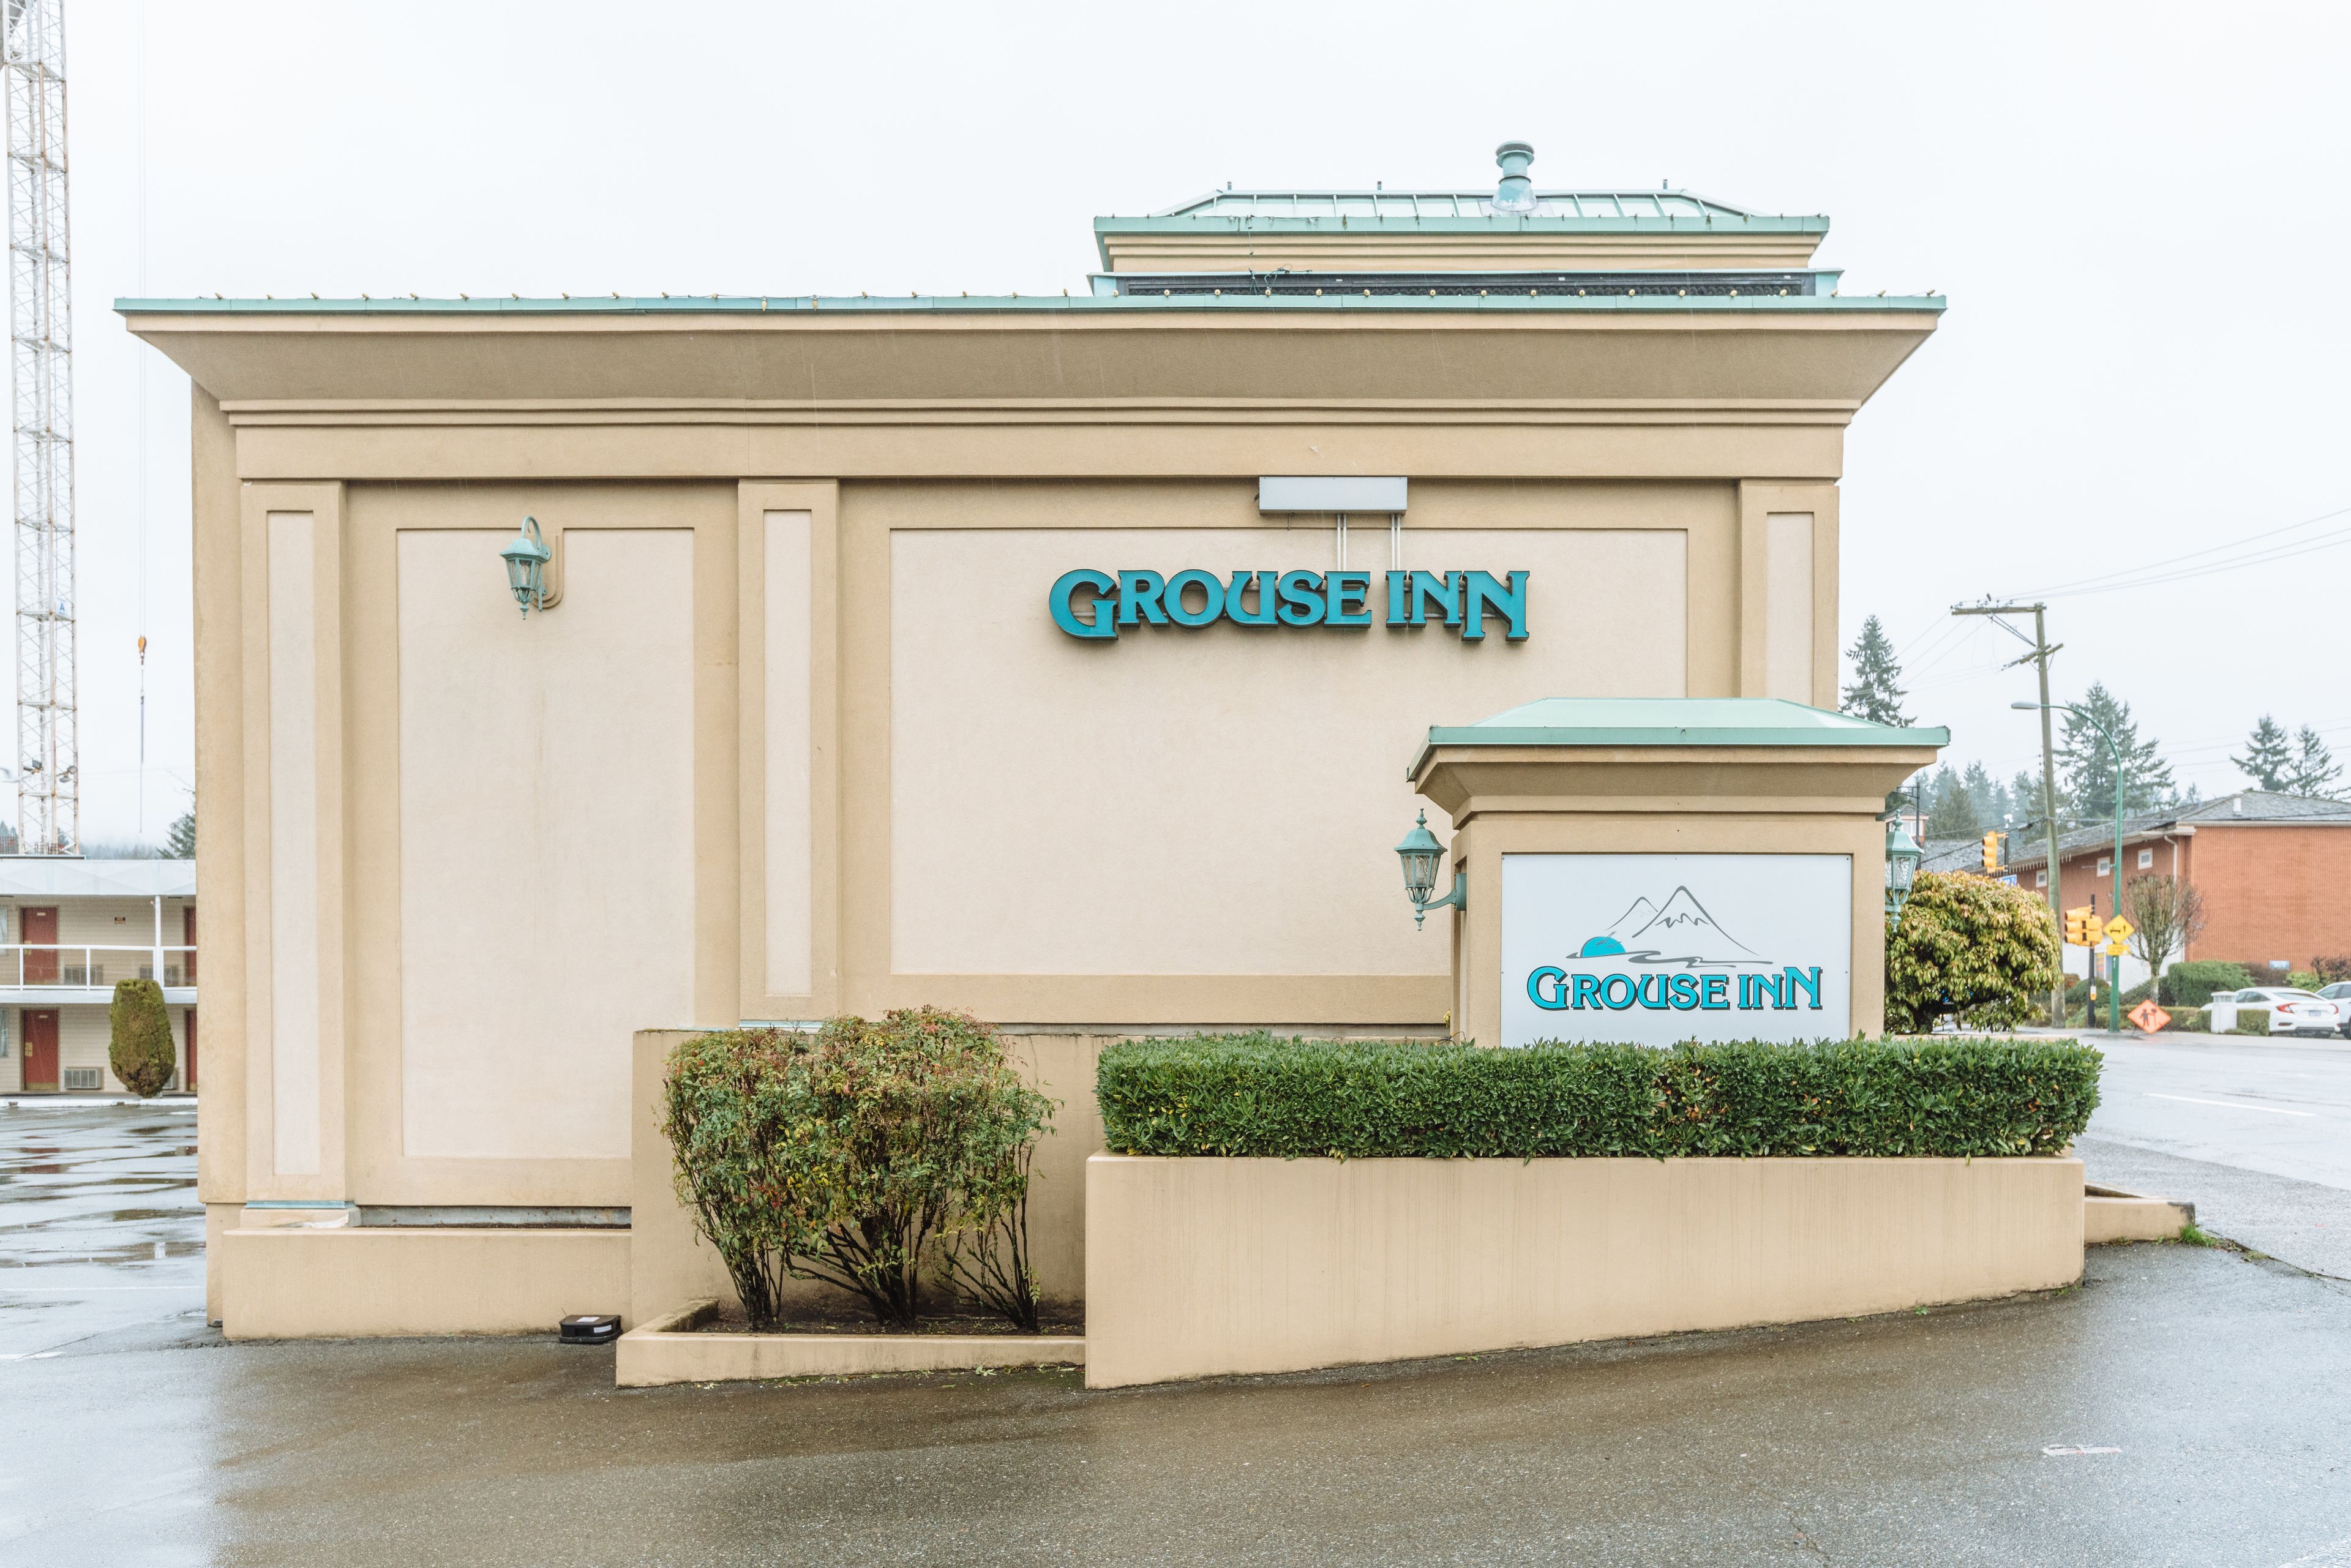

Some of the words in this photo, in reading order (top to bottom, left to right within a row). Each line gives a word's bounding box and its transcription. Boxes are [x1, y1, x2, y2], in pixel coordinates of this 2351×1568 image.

[1049, 569, 1371, 641] GROUSE
[1385, 570, 1530, 642] INN
[1527, 966, 1730, 1010] GROUSE
[1738, 966, 1823, 1010] INN
